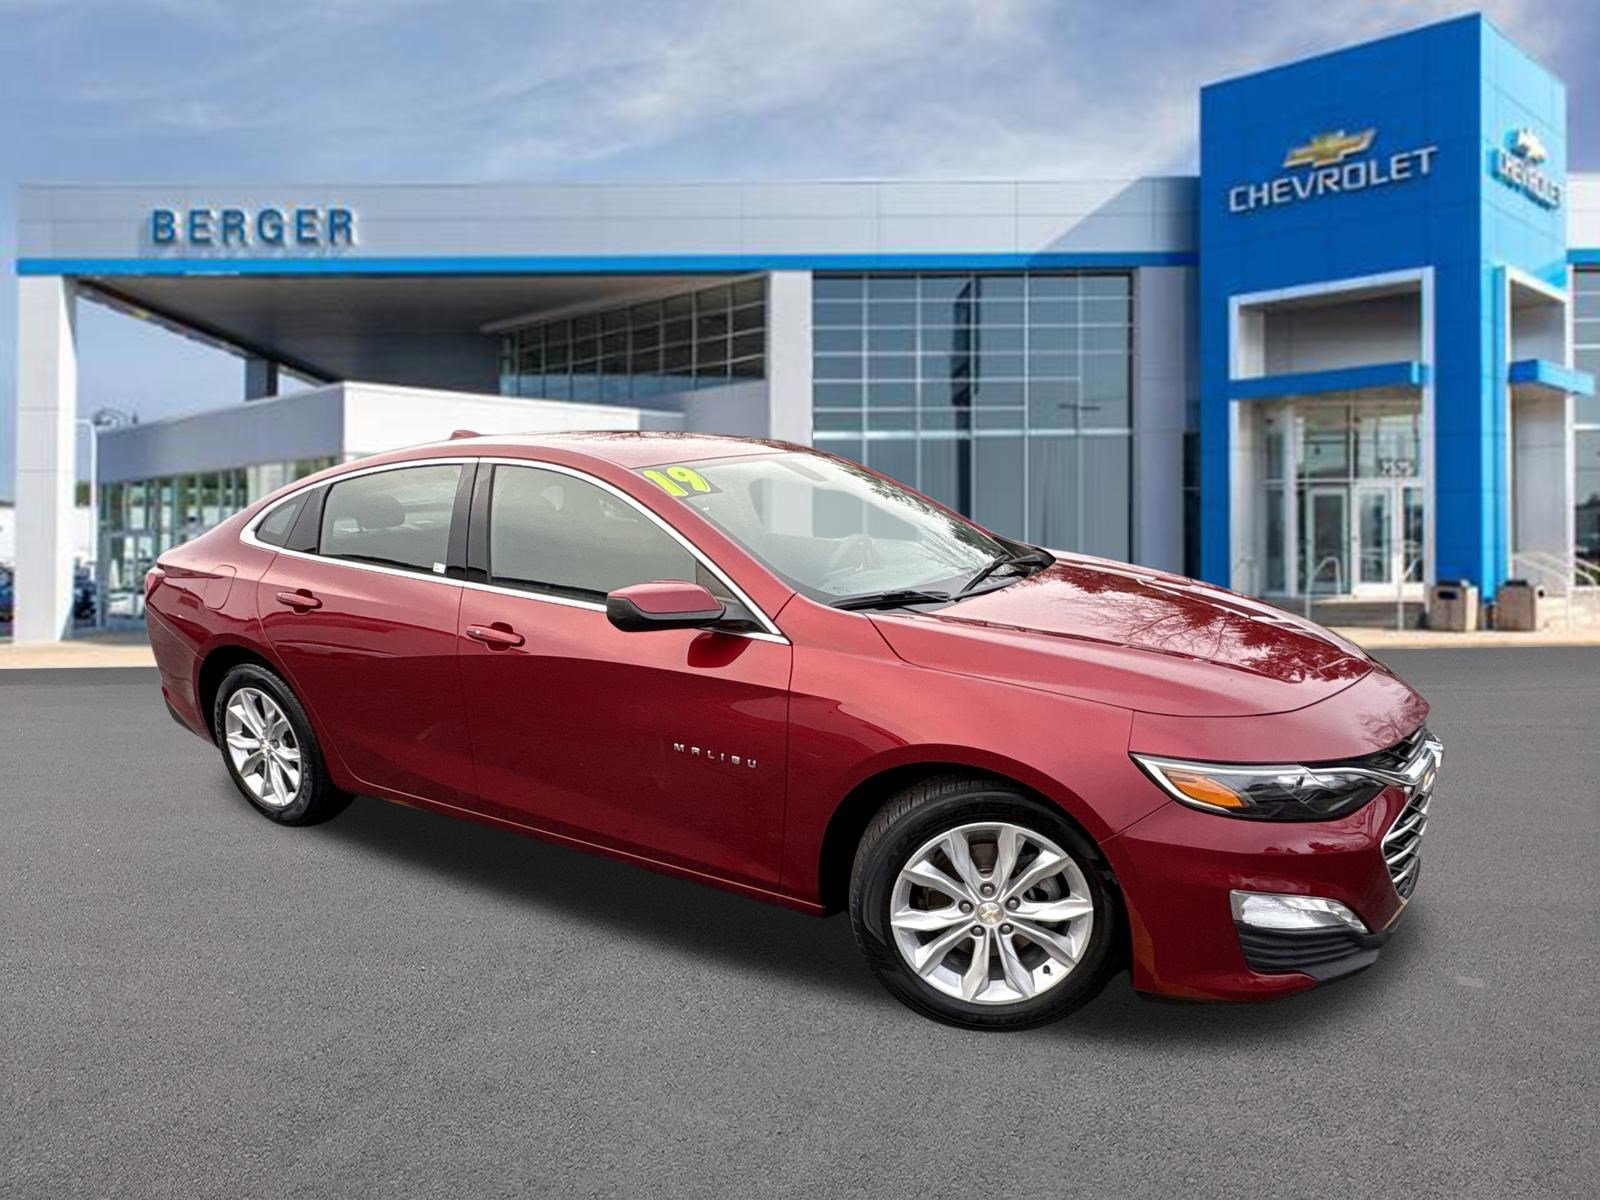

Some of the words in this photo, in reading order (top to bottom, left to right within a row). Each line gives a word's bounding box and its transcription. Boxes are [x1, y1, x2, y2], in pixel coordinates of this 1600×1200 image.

[1229, 146, 1437, 212] CHEVROLET
[152, 208, 357, 247] BERGER
[642, 466, 711, 497] 19
[673, 742, 757, 769] MALIBU
